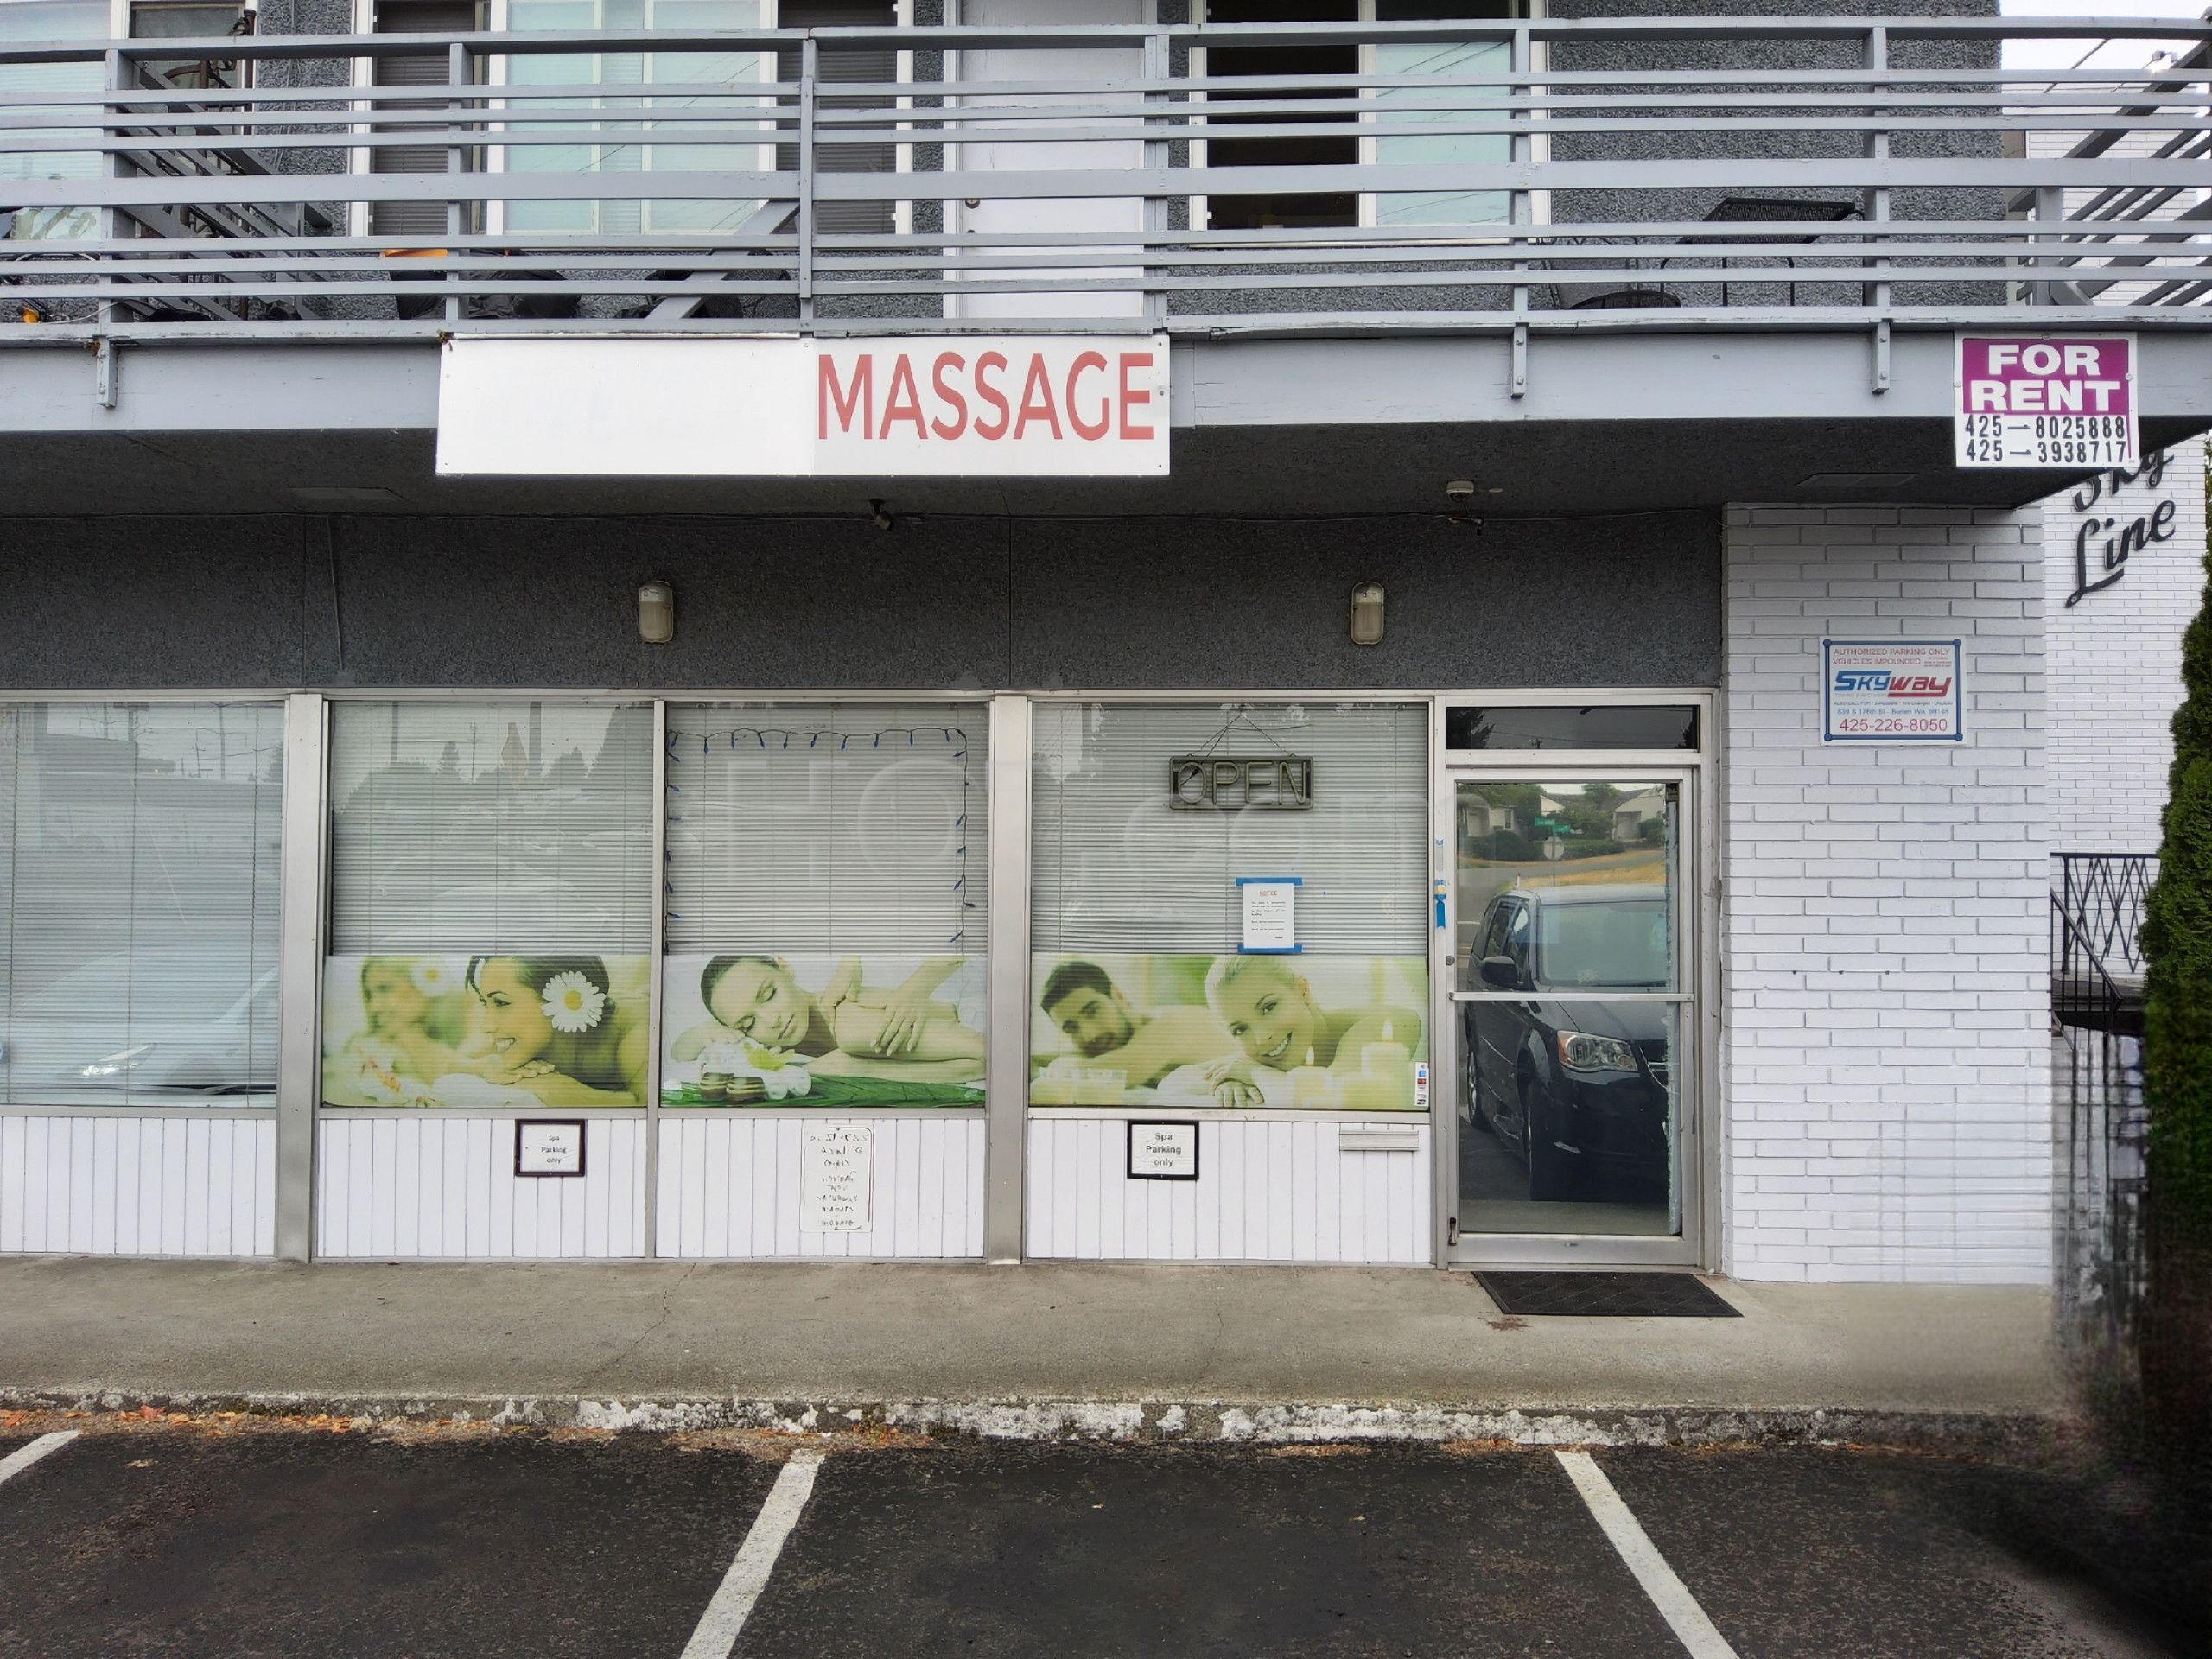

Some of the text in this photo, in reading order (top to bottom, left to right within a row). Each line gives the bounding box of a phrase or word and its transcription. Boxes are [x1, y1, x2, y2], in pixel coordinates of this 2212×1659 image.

[1988, 344, 2100, 376] FOR
[818, 351, 1154, 440] MASSAGE
[1970, 379, 2120, 412] RENT
[2065, 499, 2176, 608] Line
[1840, 718, 1948, 732] 425-226-8050
[1177, 760, 1307, 806] OPEN
[1146, 1145, 1182, 1155] Parking
[1154, 1132, 1173, 1141] Spa
[1154, 1158, 1173, 1167] only
